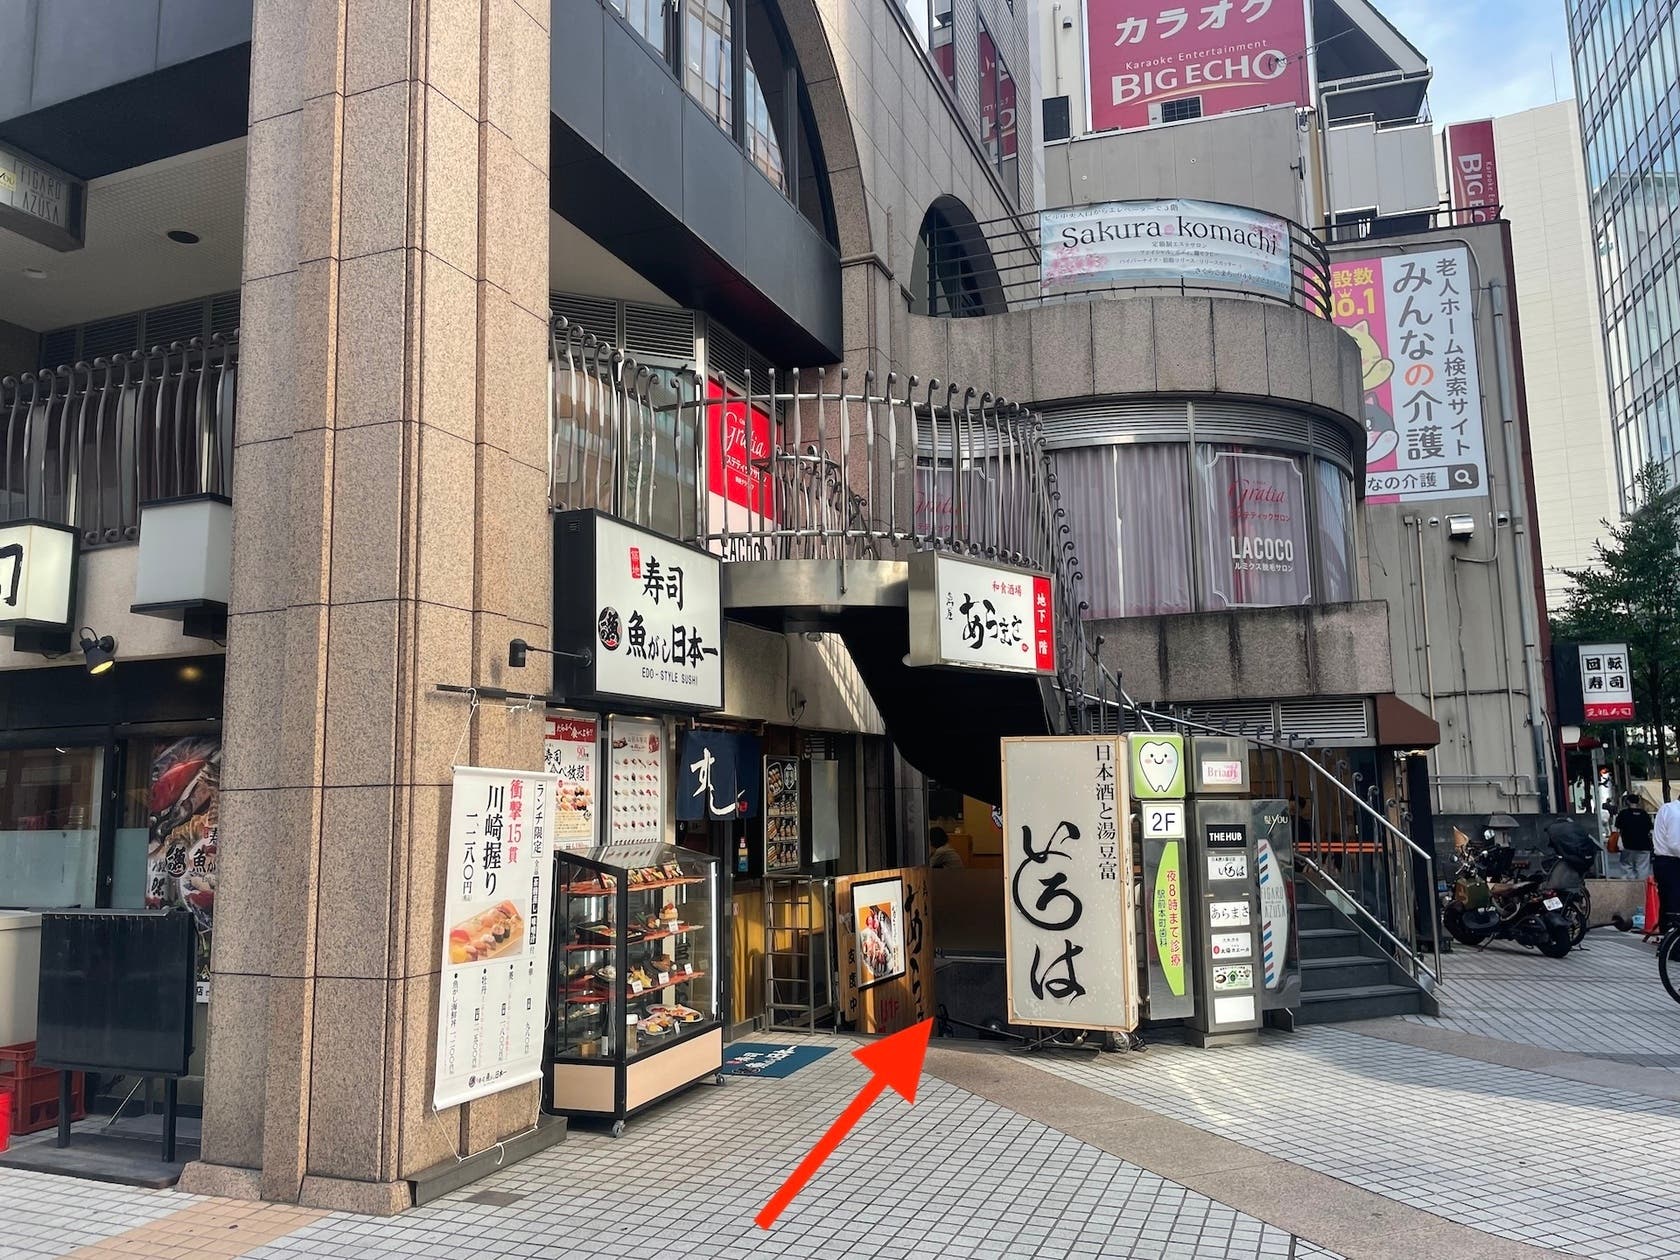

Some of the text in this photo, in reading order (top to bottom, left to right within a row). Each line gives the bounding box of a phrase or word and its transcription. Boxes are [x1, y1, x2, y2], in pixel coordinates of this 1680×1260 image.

[1125, 39, 1269, 71] Karaoke Entertainment
[1111, 49, 1289, 106] BIG ECHO
[22, 165, 62, 200] FIGARO
[1458, 153, 1483, 196] BIG
[22, 191, 60, 224] AZUSA
[1061, 216, 1278, 256] Sakura komachi
[1392, 262, 1446, 461] みんなの介護
[1436, 258, 1471, 456] 老人ホーム検索サイト
[1366, 473, 1438, 492] なの介護
[1230, 535, 1294, 562] LACOCO
[642, 555, 684, 611] 寿司
[626, 610, 718, 669] 魚がし日本一
[1037, 592, 1048, 655] 地下一階
[681, 673, 698, 686] SUSHI
[1585, 657, 1623, 671] 回転
[1588, 675, 1625, 690] 寿司
[507, 779, 524, 864] 衝撃15貫
[533, 783, 544, 854] ランチ限定
[1096, 744, 1117, 881] 日本酒と湯豆富
[1152, 812, 1176, 832] 2F
[482, 785, 505, 897] 川崎握り
[1209, 832, 1242, 842] THE HUB
[1012, 820, 1087, 1006] いろは
[1167, 870, 1181, 967] 夜8時まで診療
[1211, 904, 1249, 920] あらまさ
